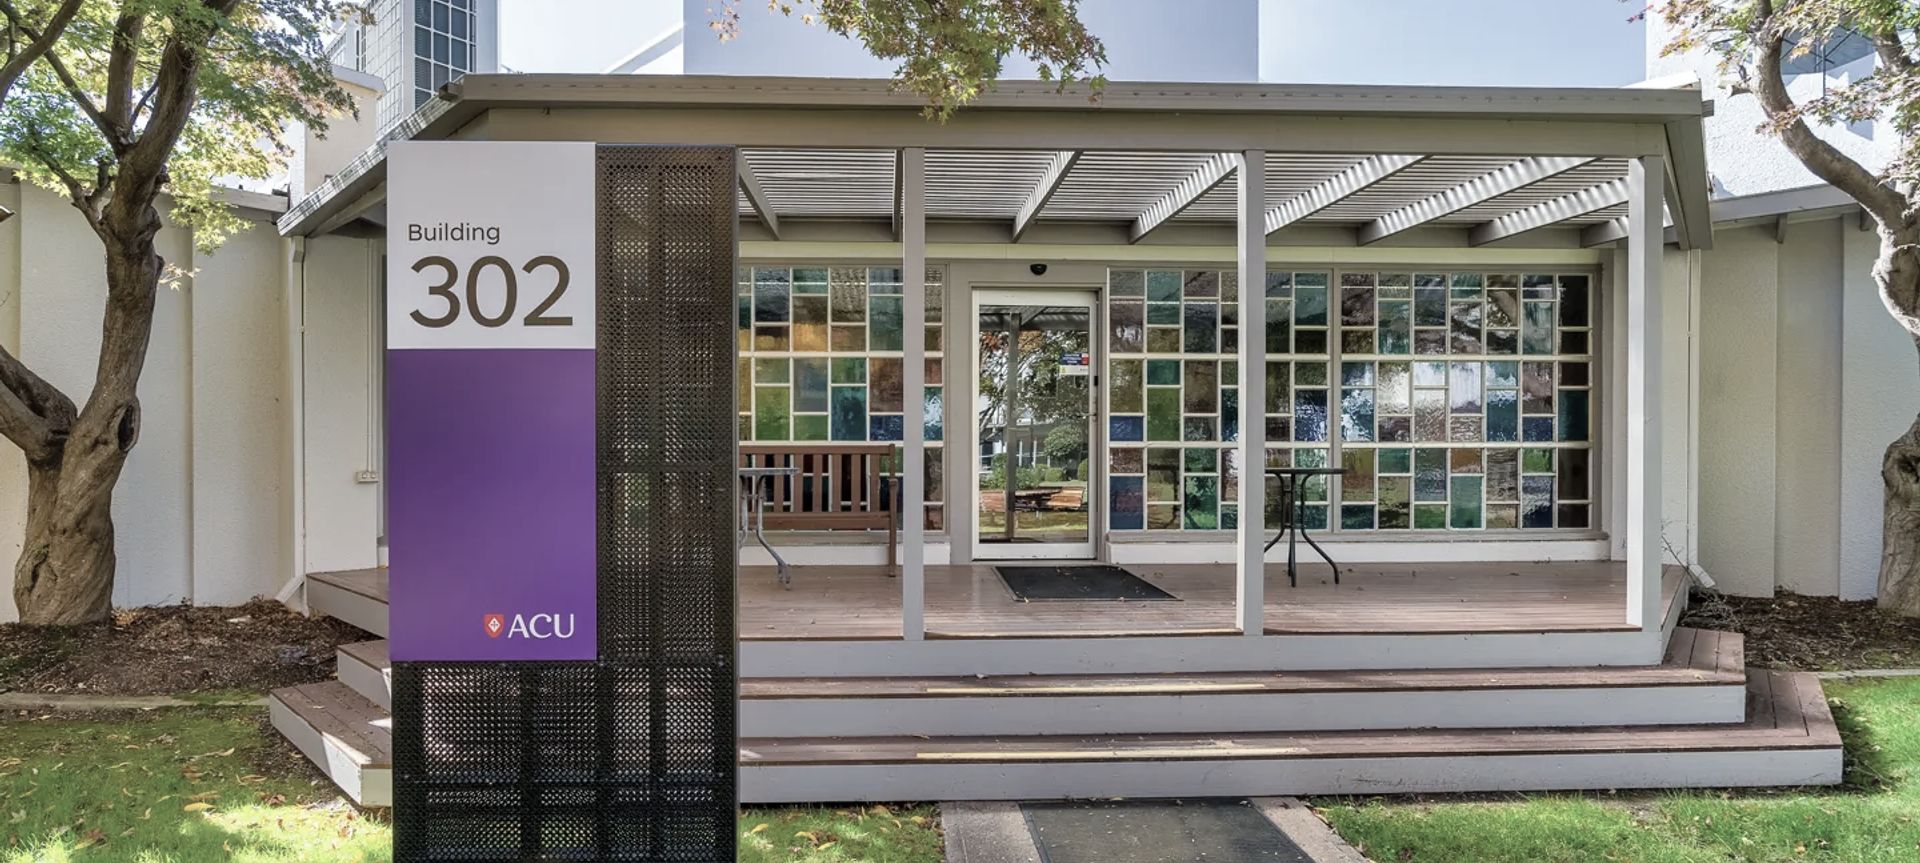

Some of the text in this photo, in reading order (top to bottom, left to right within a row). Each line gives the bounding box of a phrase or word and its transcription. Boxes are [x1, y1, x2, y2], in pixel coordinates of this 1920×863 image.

[408, 223, 500, 245] Building
[410, 255, 573, 328] 302
[507, 613, 574, 638] ACU
